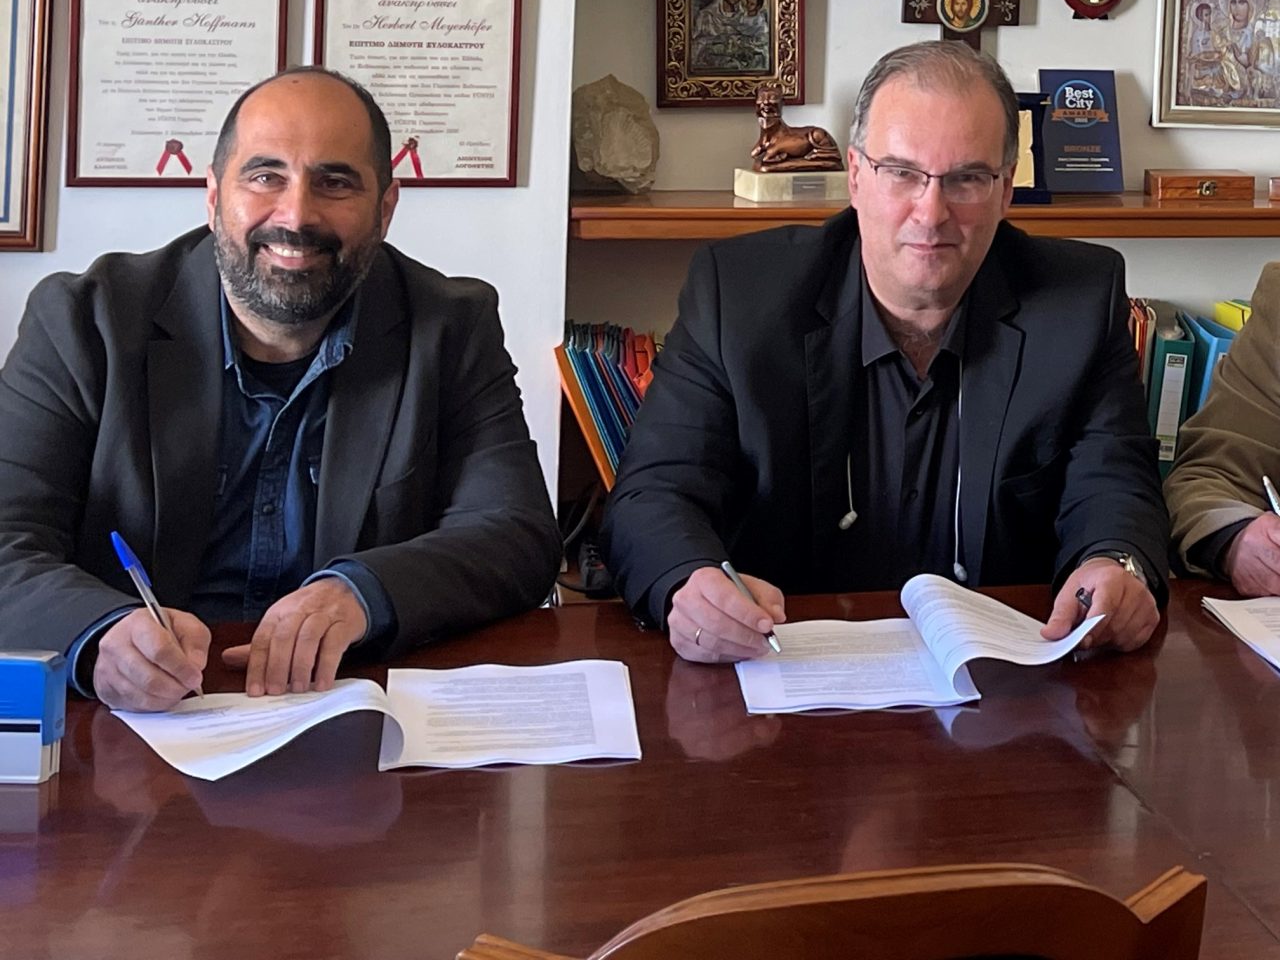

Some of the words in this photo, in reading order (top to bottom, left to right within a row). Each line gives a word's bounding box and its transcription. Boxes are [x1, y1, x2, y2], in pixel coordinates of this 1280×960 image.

[182, 12, 256, 33] Hoffmann
[361, 14, 416, 31] Herbert
[426, 41, 486, 50] ΞΥΛΟΚΑΣΤΡΟΥ
[1064, 86, 1094, 99] Best
[1065, 97, 1094, 111] City
